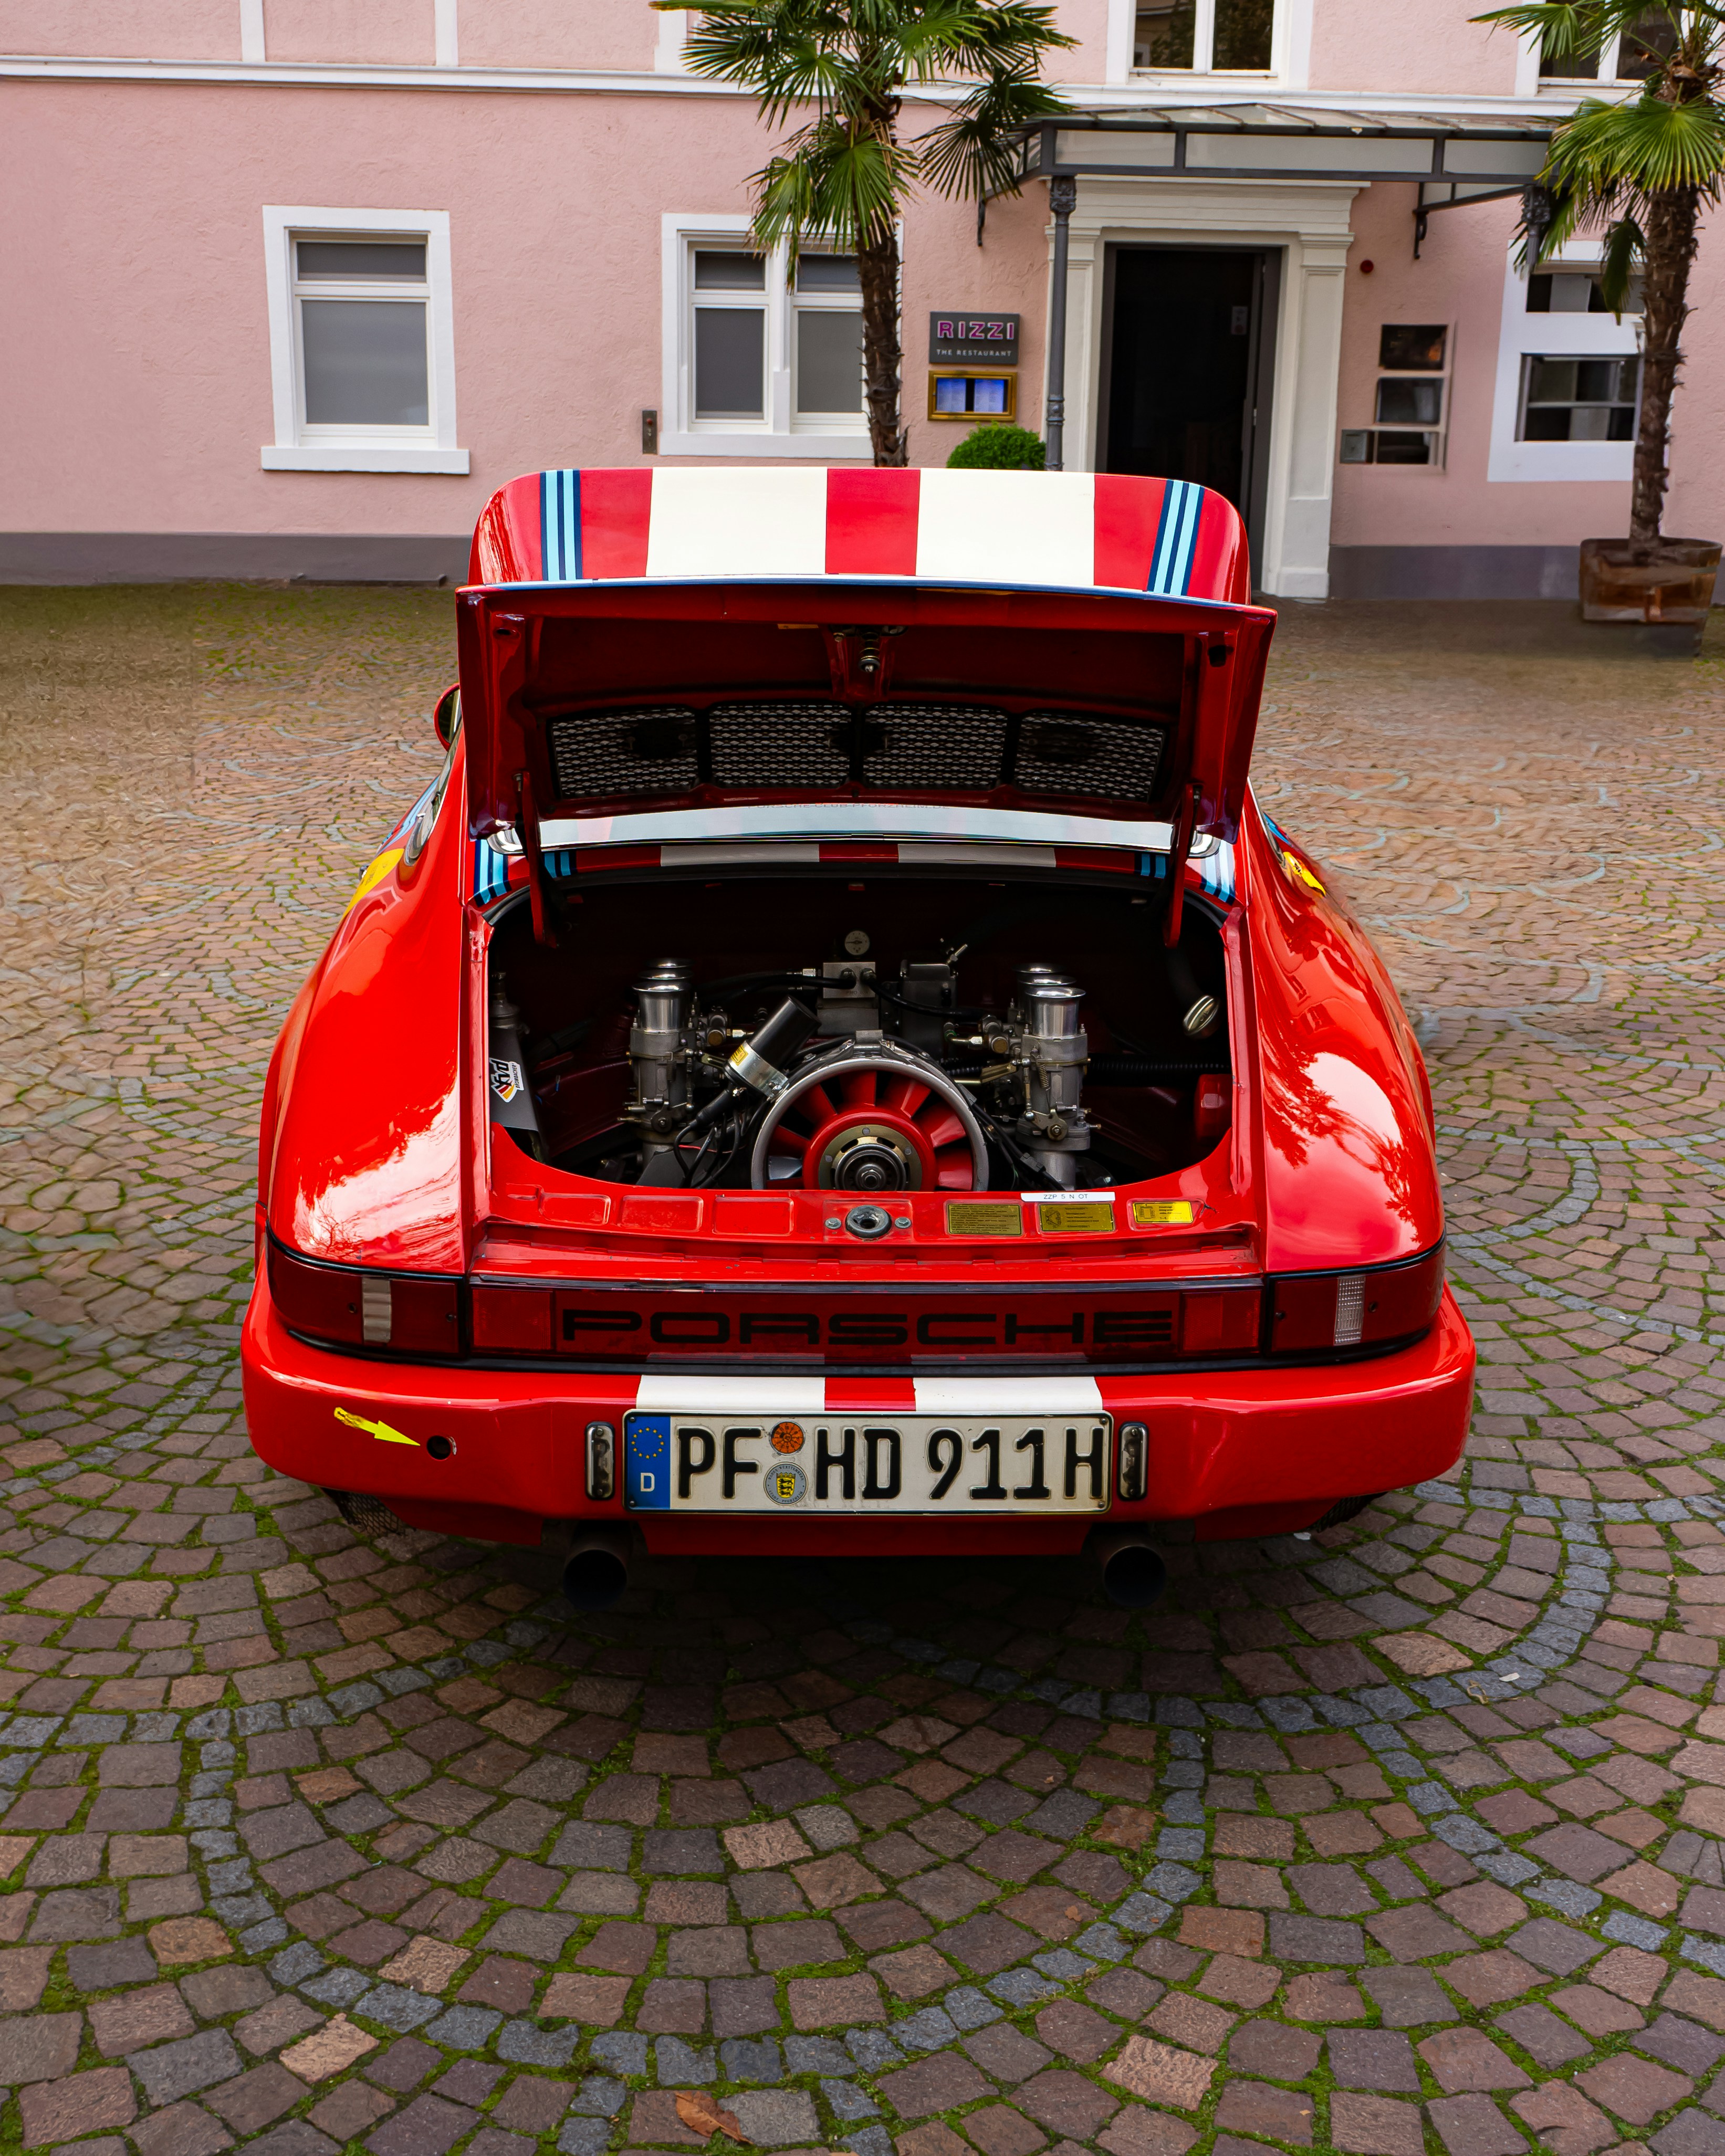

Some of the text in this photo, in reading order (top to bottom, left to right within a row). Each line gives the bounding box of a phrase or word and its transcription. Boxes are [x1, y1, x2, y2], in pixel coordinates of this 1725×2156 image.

[937, 321, 1015, 340] RIZZI
[562, 1309, 1173, 1345] PORSCHE
[677, 1426, 762, 1499] PF
[815, 1426, 902, 1500] HD
[926, 1427, 1104, 1500] 911H
[641, 1473, 655, 1492] D
